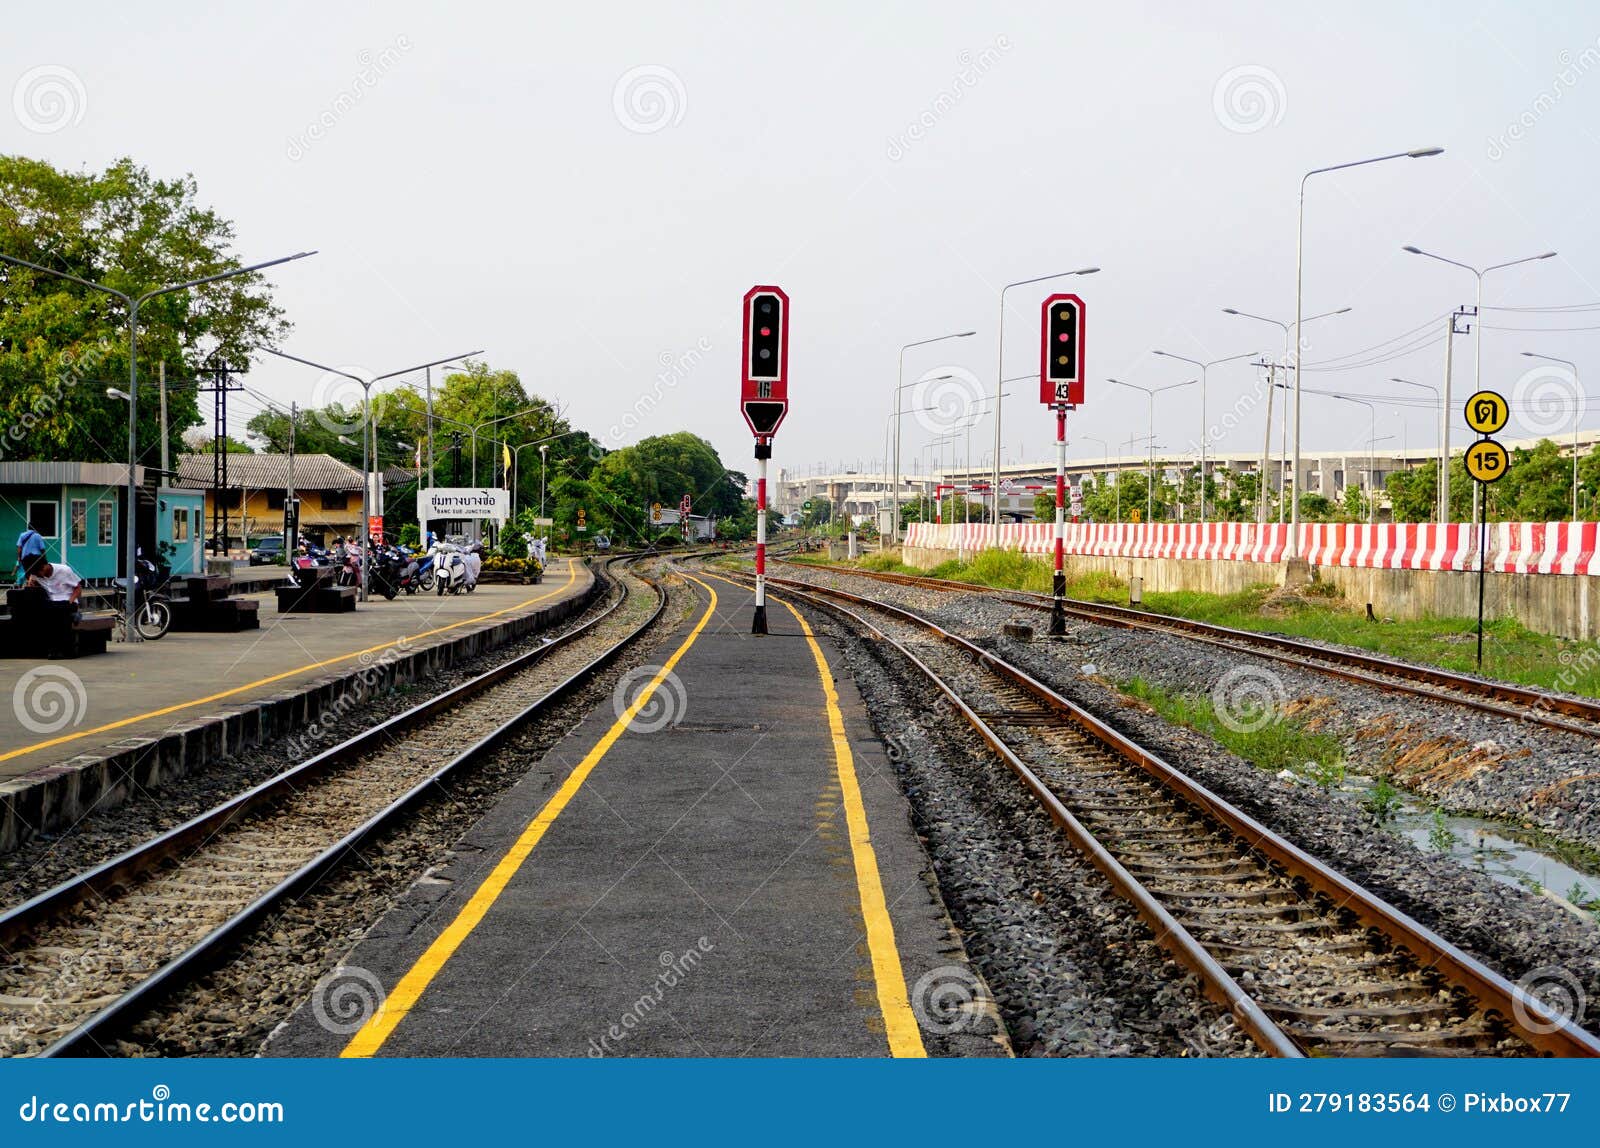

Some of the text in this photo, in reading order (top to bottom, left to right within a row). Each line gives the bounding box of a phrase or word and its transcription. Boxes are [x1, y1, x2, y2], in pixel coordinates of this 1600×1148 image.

[758, 381, 770, 398] 16
[1055, 384, 1069, 399] 43
[1473, 451, 1500, 472] 15
